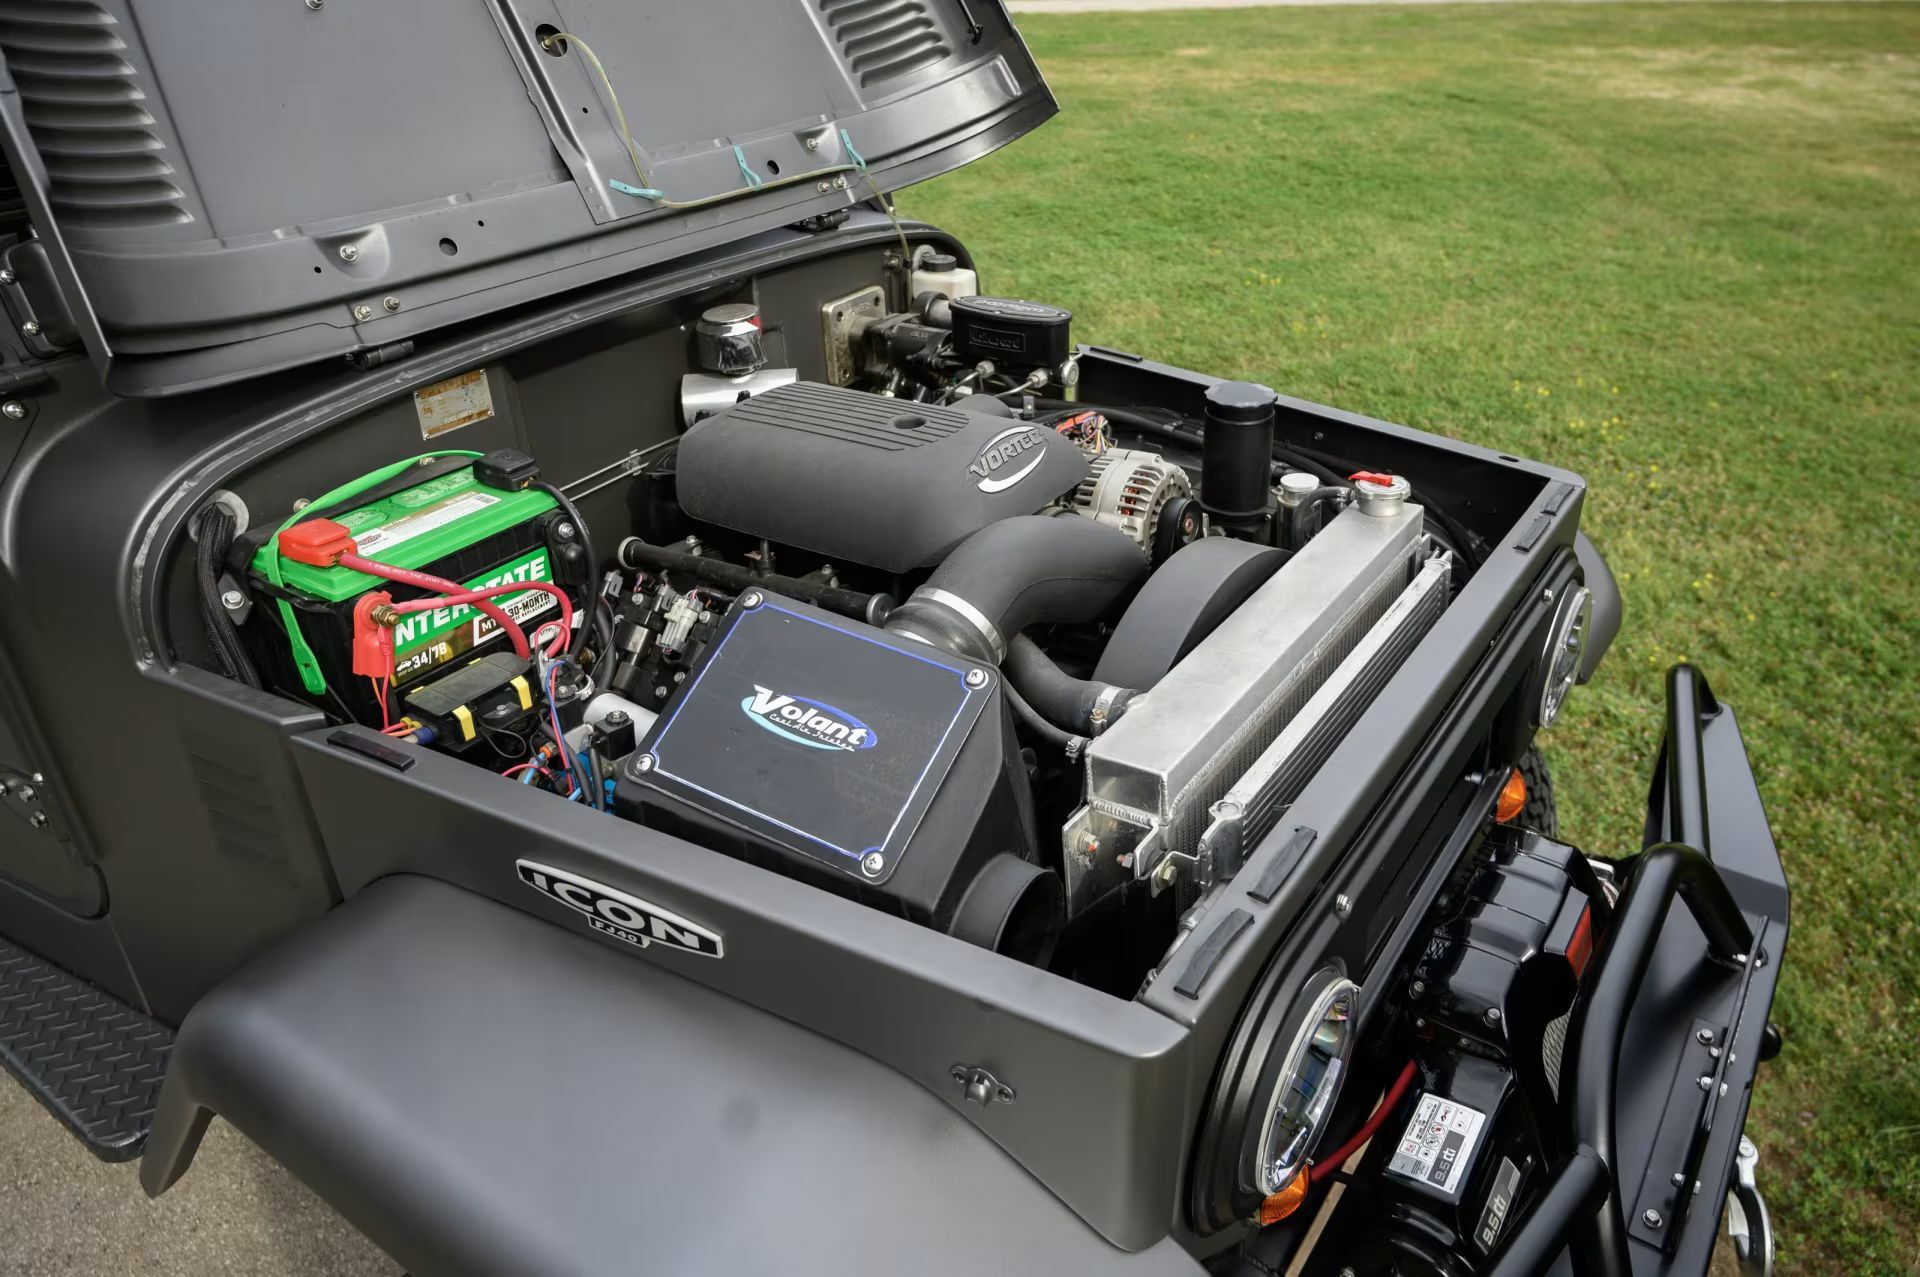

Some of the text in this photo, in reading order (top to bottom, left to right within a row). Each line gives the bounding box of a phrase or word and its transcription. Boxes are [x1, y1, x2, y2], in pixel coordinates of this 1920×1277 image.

[970, 428, 1044, 477] VORTEC
[508, 592, 550, 618] 30-MONTH
[412, 641, 448, 669] 34/78
[750, 684, 869, 745] Volant
[533, 872, 700, 950] ICON
[595, 920, 638, 943] FJ40
